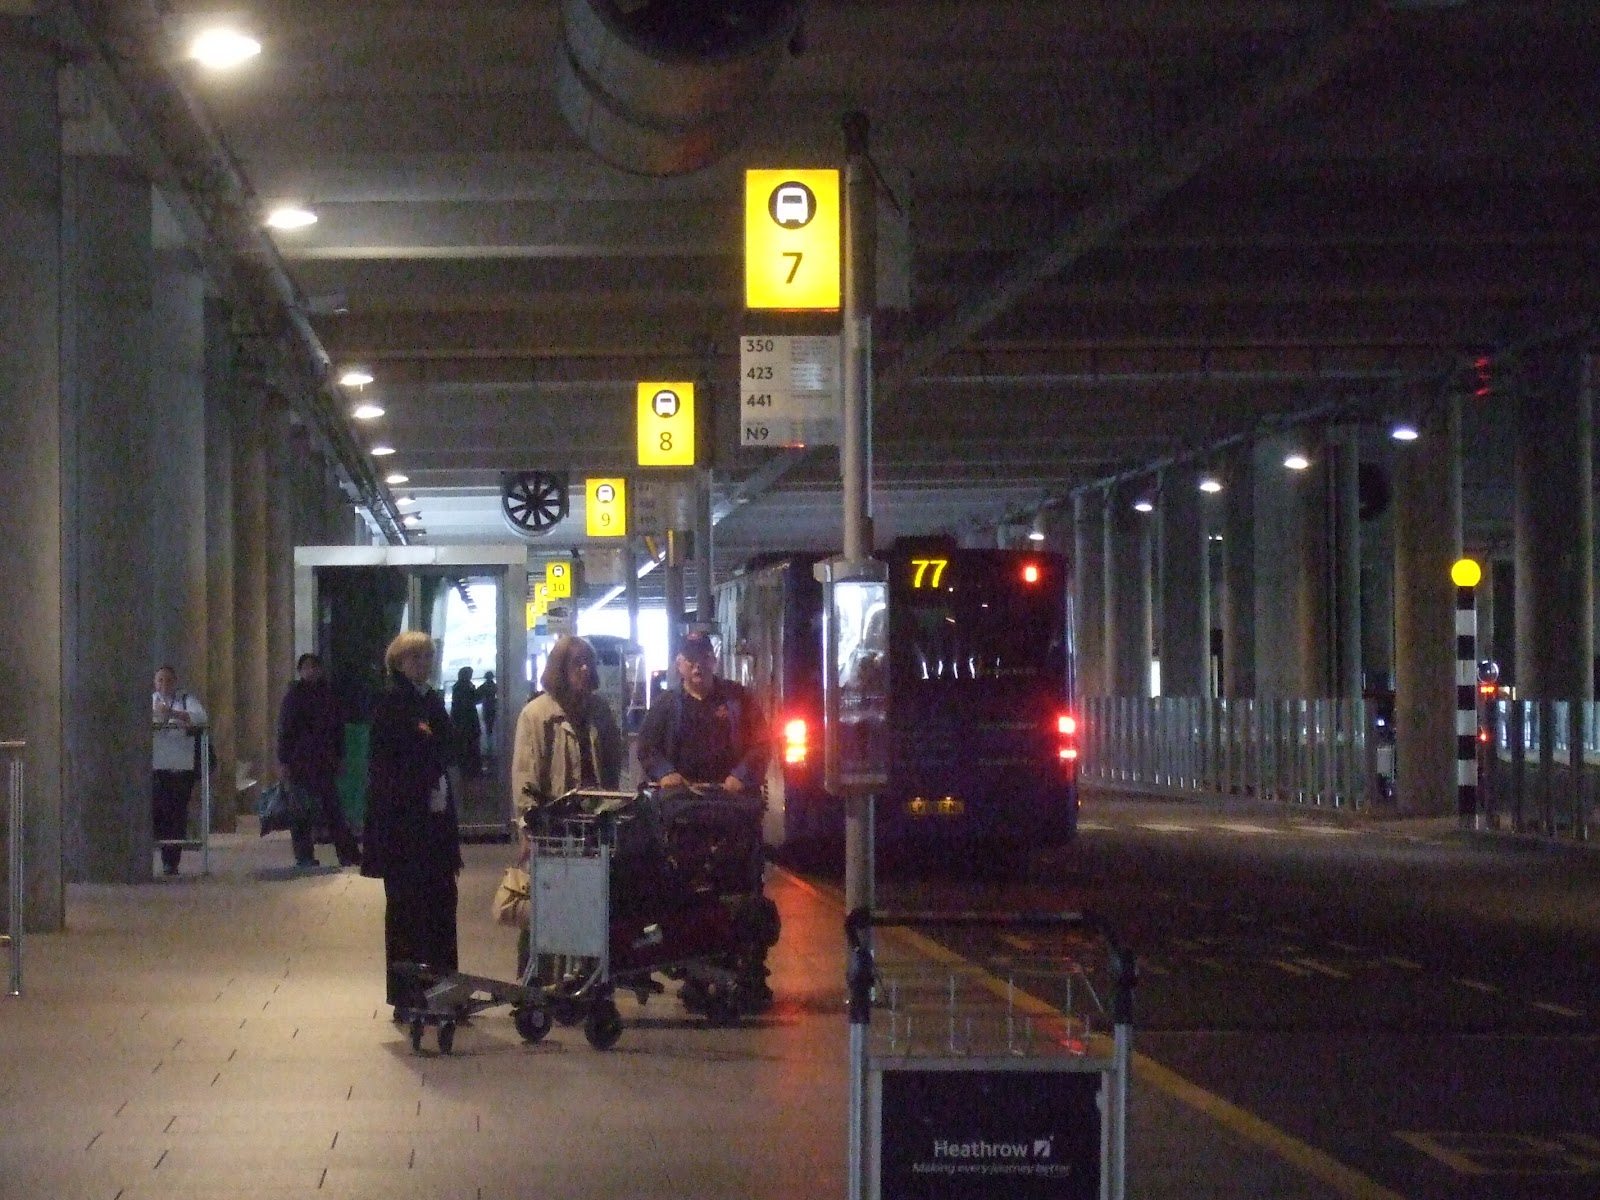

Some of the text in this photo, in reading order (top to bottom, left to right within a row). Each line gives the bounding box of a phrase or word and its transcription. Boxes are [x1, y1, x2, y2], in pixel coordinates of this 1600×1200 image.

[782, 252, 803, 285] 7
[746, 339, 774, 352] 350
[746, 366, 774, 380] 423
[746, 394, 772, 407] 441
[746, 427, 769, 440] N9
[659, 432, 673, 451] 8
[601, 512, 610, 527] 9
[911, 559, 948, 588] 77
[552, 583, 565, 592] 10
[933, 1139, 1028, 1158] Heathrow
